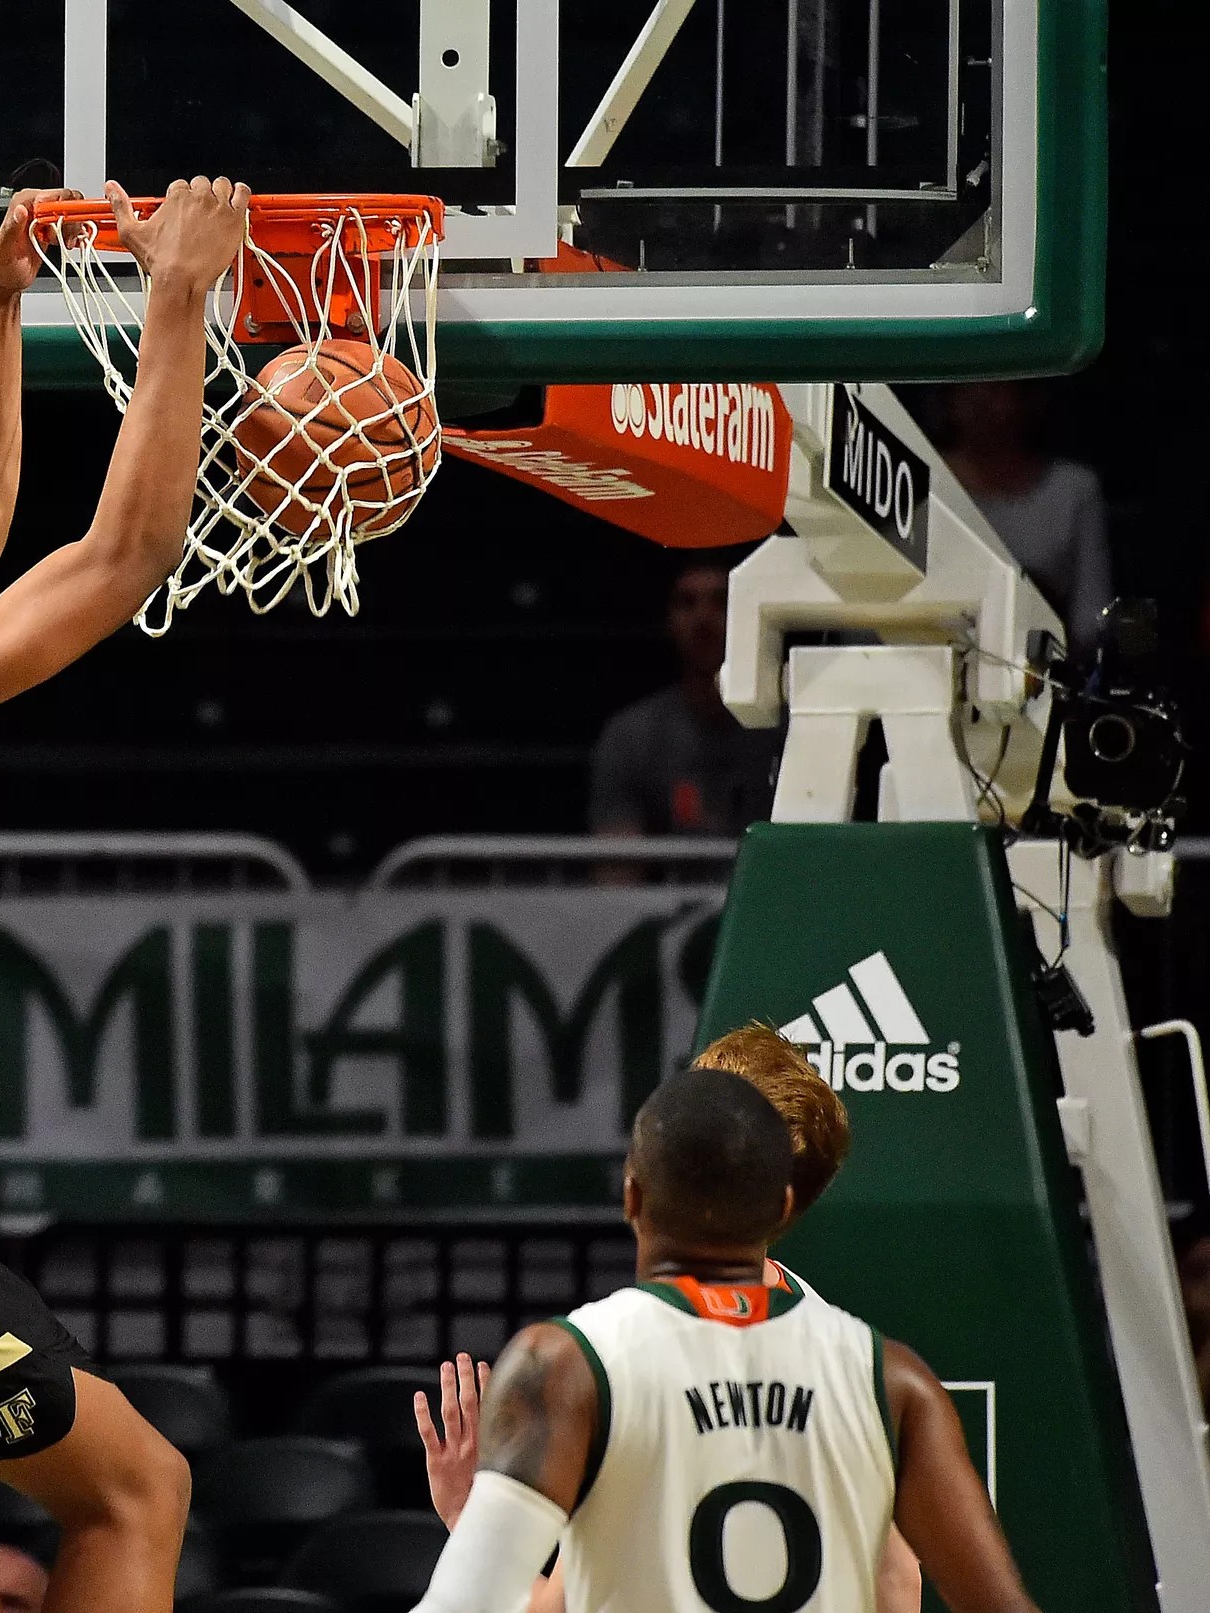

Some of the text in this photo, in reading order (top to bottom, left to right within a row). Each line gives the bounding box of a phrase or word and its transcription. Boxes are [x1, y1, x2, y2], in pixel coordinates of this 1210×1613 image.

[843, 410, 914, 539] MIDO
[807, 1040, 960, 1092] didas
[686, 1381, 814, 1434] NEWTON
